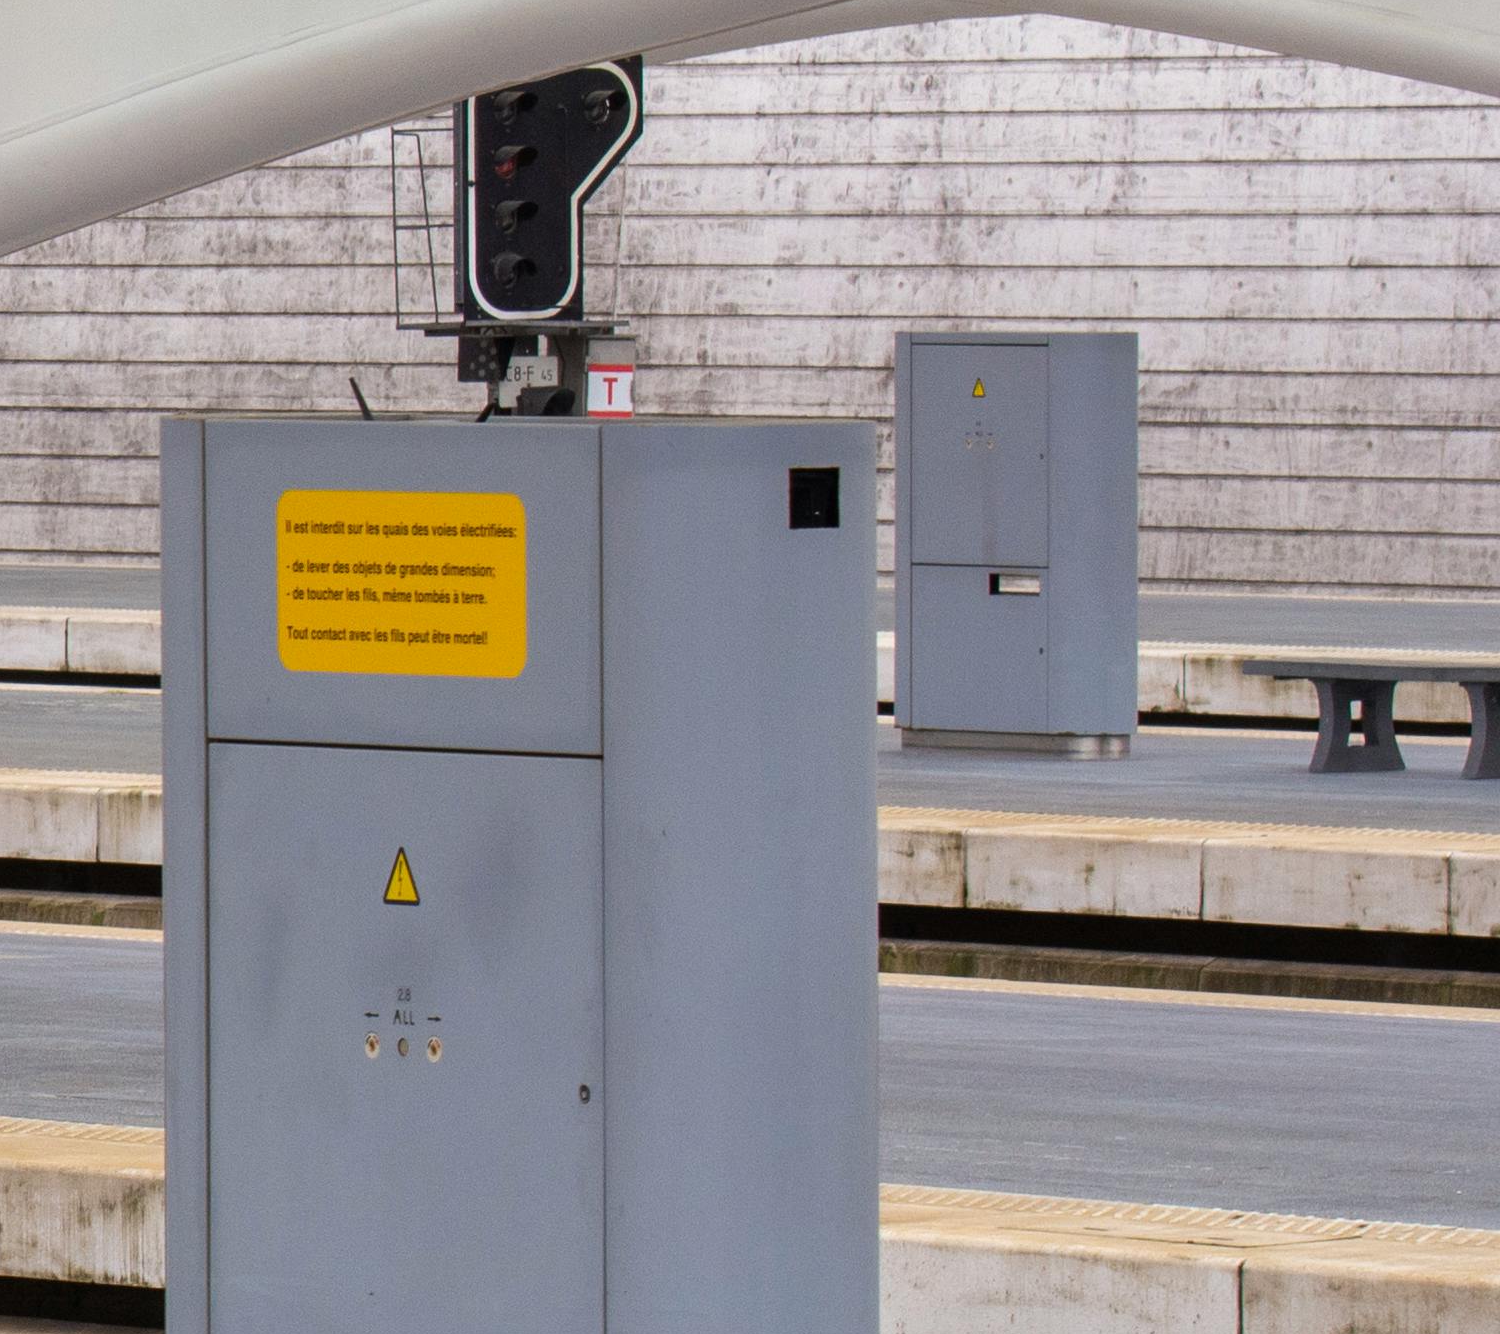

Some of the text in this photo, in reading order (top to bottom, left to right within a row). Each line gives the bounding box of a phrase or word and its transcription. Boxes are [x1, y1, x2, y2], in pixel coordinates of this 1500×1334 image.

[603, 377, 618, 406] T
[294, 522, 309, 534] est
[311, 521, 345, 534] interdit
[347, 523, 363, 535] sur
[365, 521, 380, 535] les
[382, 522, 409, 538] quais
[411, 523, 428, 536] des
[431, 523, 458, 537] voies
[292, 560, 305, 573] de
[307, 560, 330, 573] lever
[332, 561, 350, 574] des
[352, 561, 382, 578] objets
[384, 561, 397, 575] de
[399, 562, 439, 578] grandes
[292, 587, 305, 600] de
[307, 588, 344, 601] toucher
[346, 588, 360, 601] les
[363, 588, 380, 603] fils,
[382, 588, 412, 602] même
[414, 590, 451, 604] tombés
[453, 590, 460, 604] à
[461, 592, 487, 605] terre.
[287, 626, 488, 647] Tout contact avec les fils peut être mortel!
[393, 1009, 415, 1026] ALL
